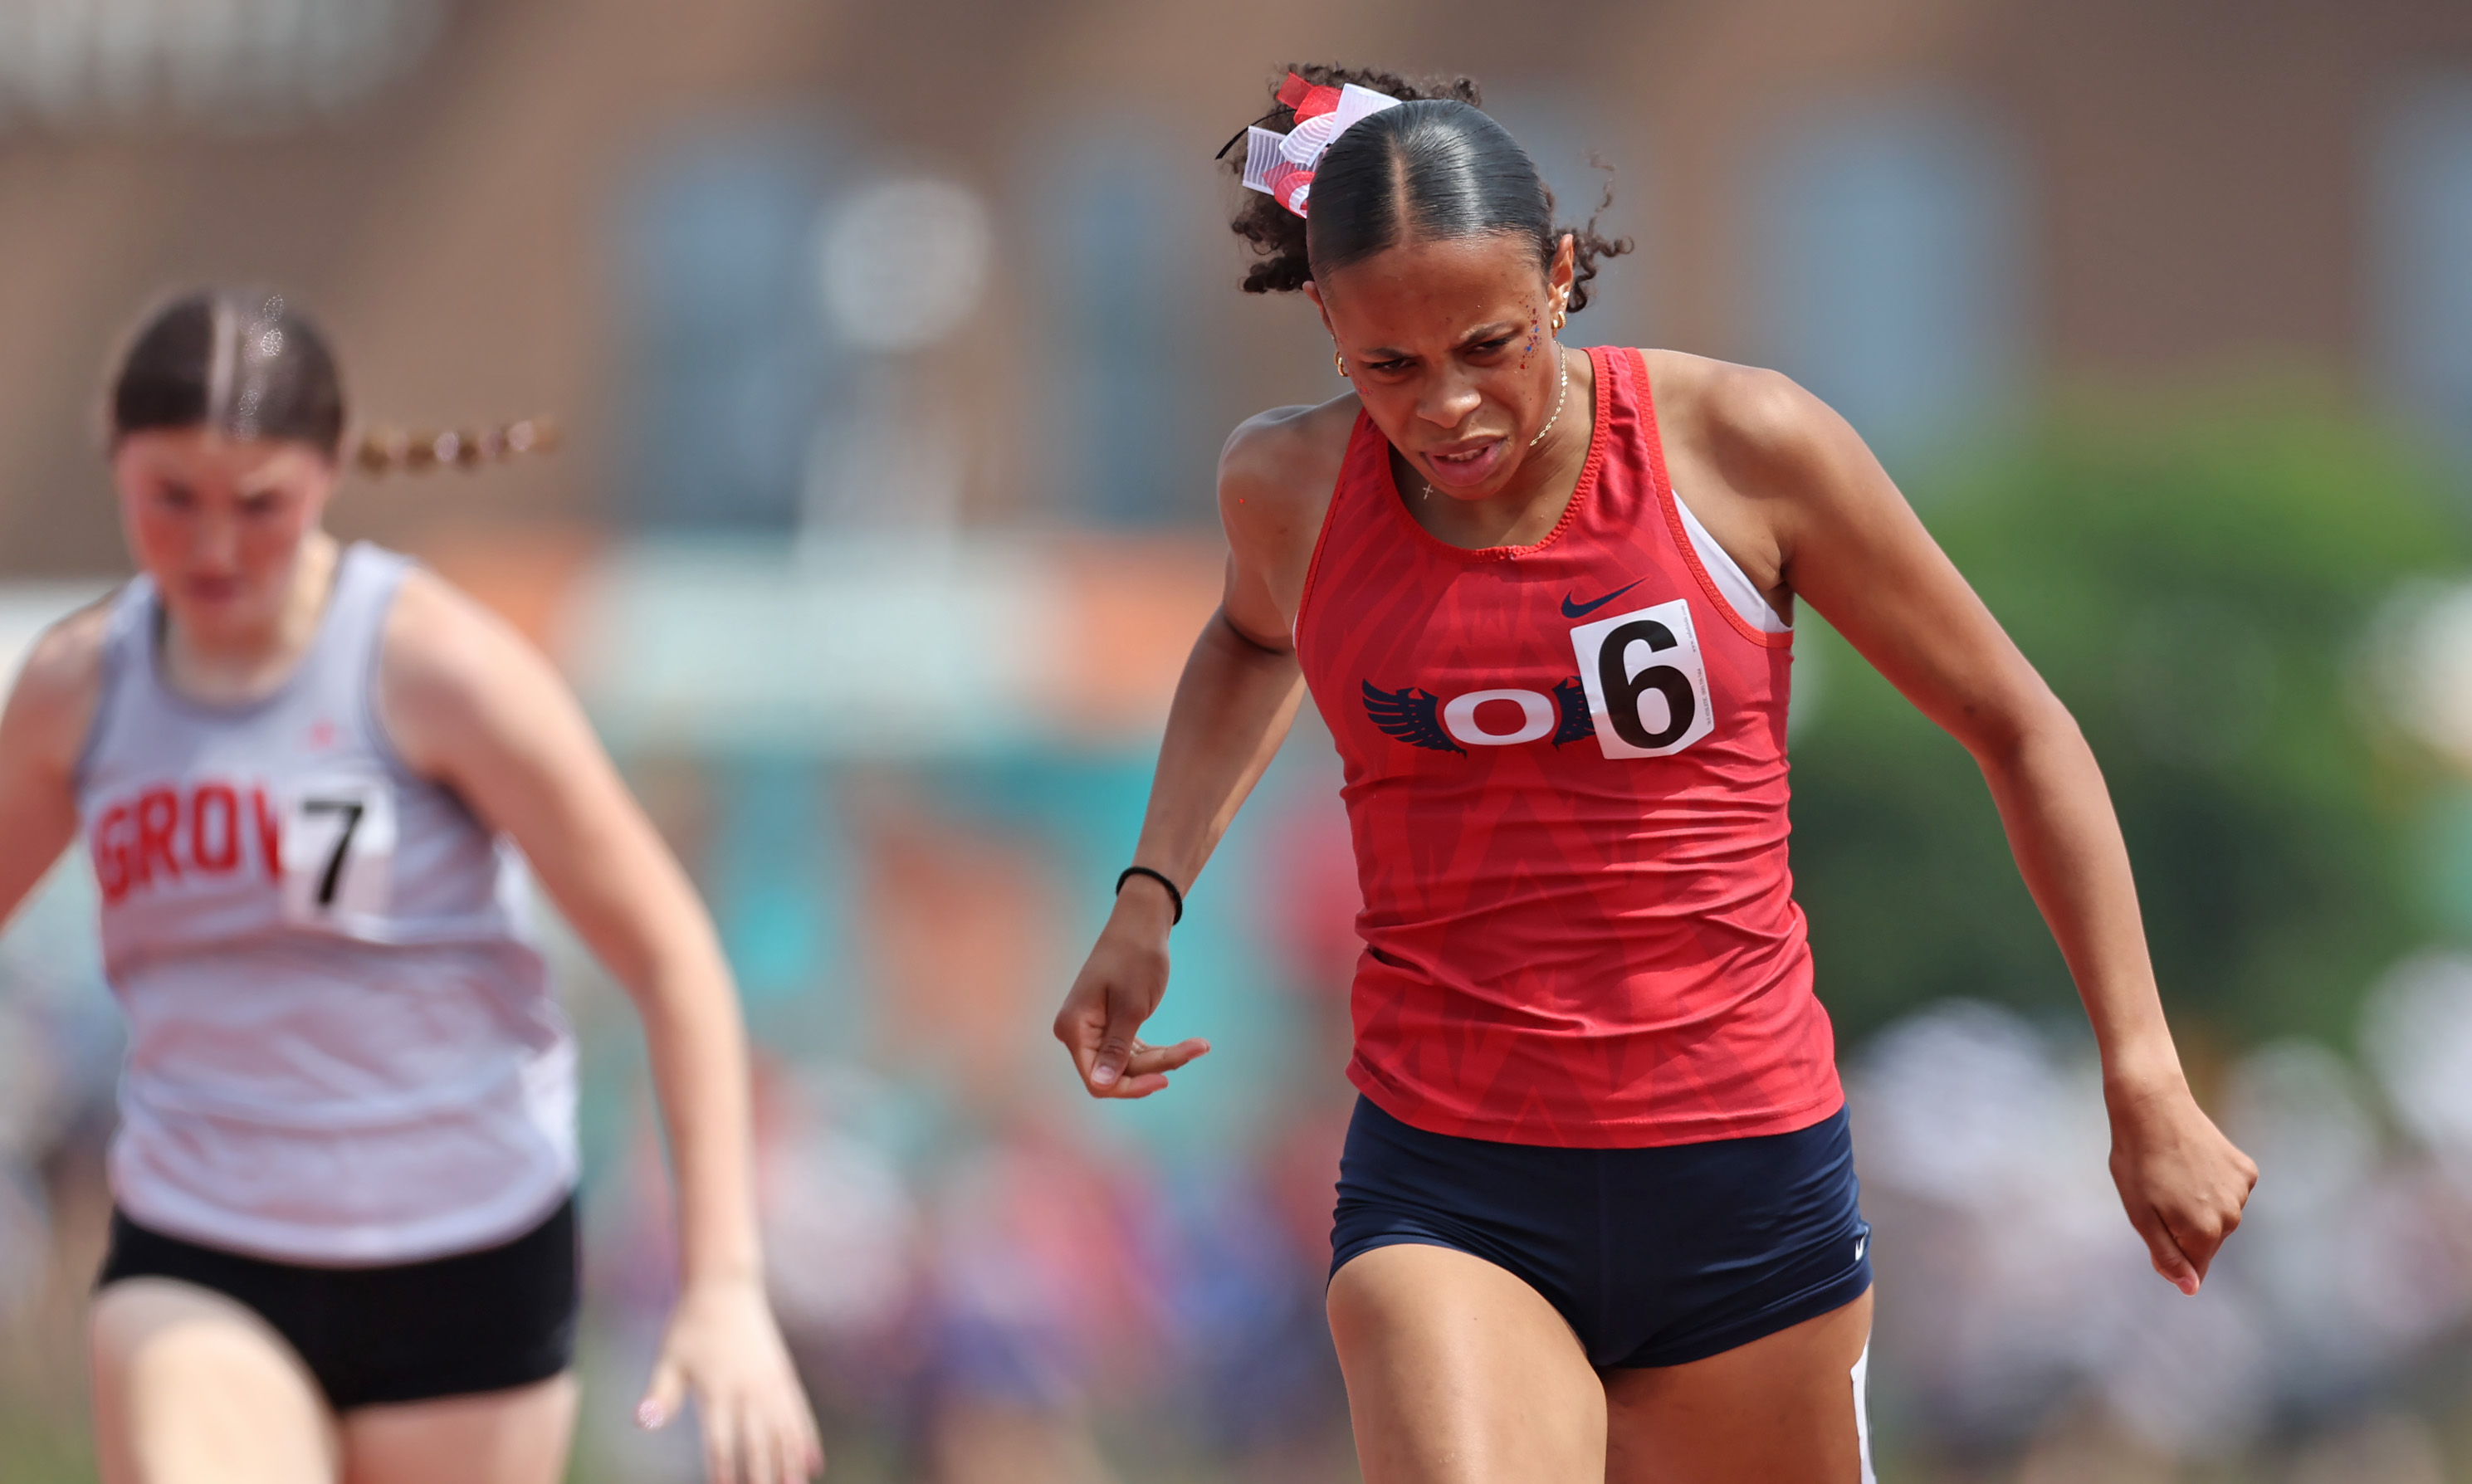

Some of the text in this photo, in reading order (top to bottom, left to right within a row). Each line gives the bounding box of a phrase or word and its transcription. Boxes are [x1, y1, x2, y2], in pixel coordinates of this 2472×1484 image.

[1444, 689, 1555, 744] O
[1599, 621, 1695, 748] 6
[301, 799, 365, 906] 7
